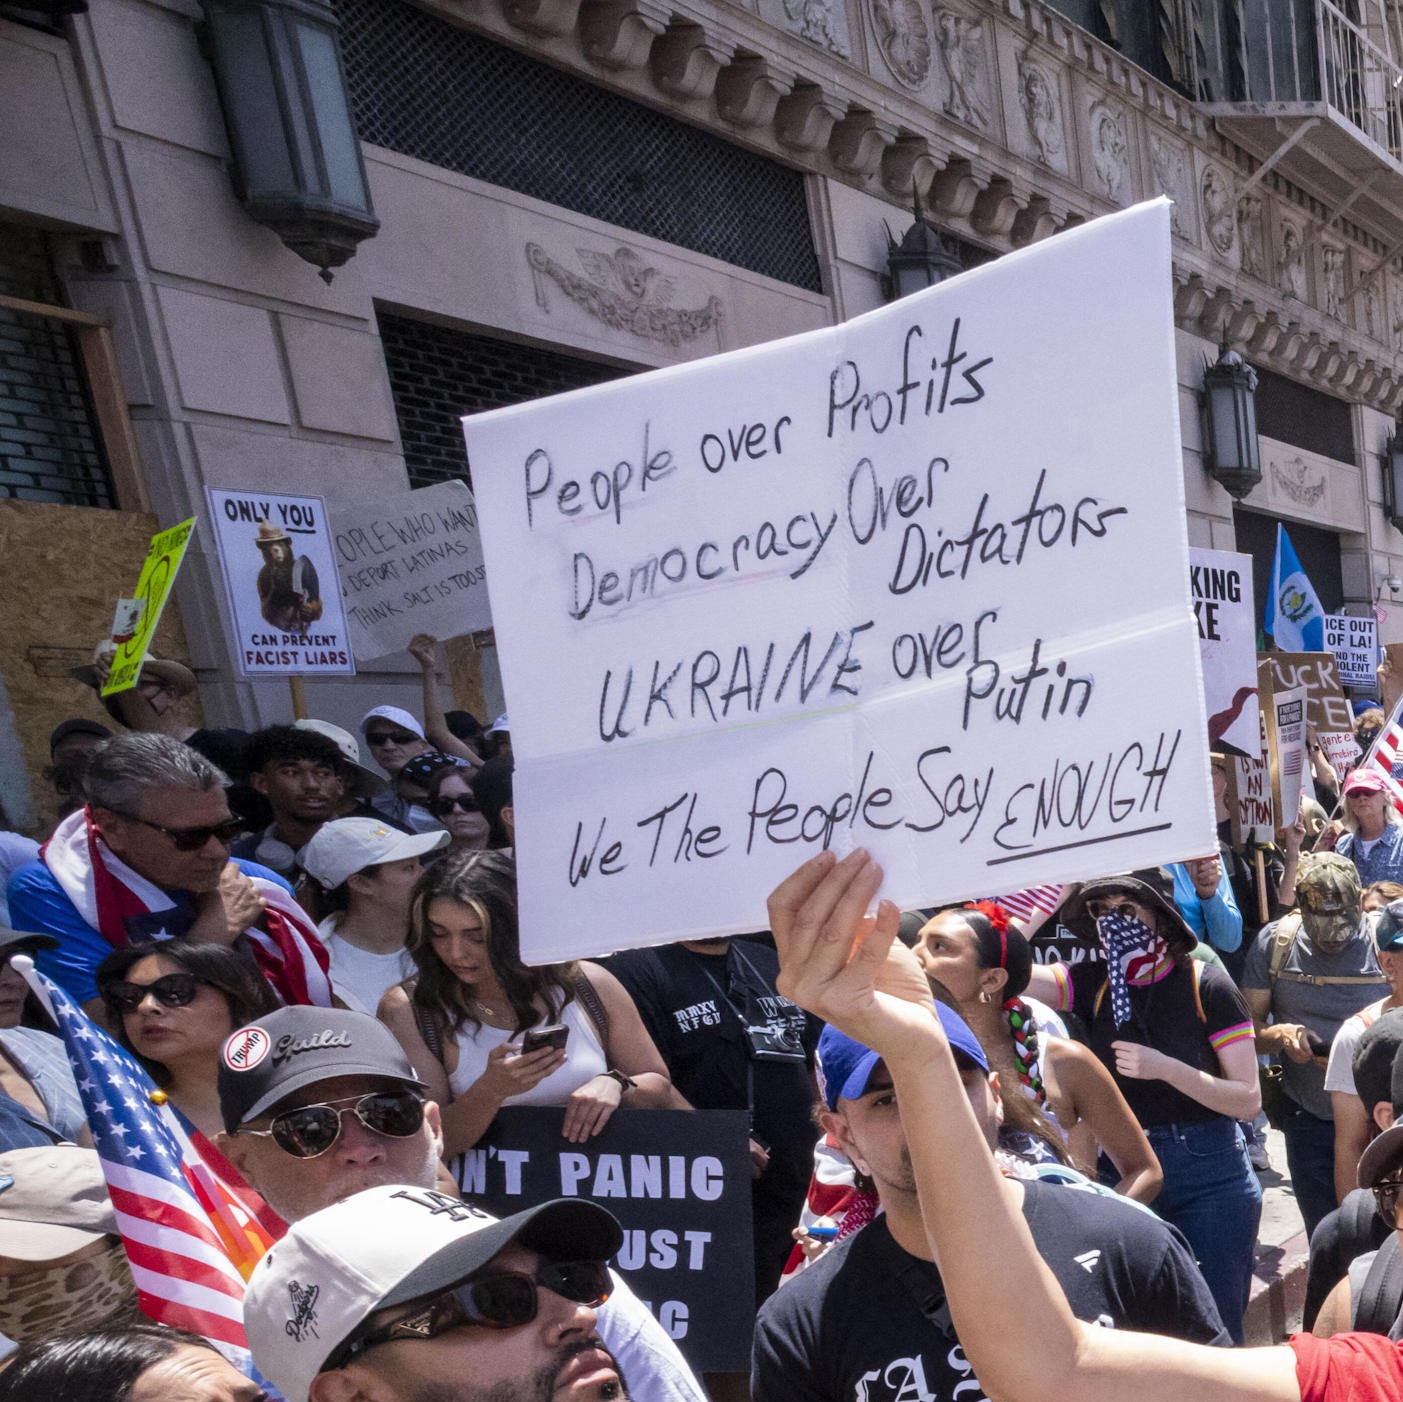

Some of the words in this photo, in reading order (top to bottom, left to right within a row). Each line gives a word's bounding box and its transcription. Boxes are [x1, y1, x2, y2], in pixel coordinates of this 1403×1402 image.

[524, 420, 676, 531] People
[700, 414, 791, 474] over
[827, 317, 994, 439] Profits
[223, 498, 271, 524] ONLY
[276, 502, 316, 528] YOU
[889, 469, 1128, 595] Dictators
[336, 520, 396, 563] OPLE
[386, 512, 437, 546] WHO
[569, 507, 838, 619] Democracy
[848, 456, 950, 546] Over
[347, 559, 401, 593] DEPORT
[401, 540, 470, 574] LATINAS
[346, 600, 405, 631] THINK
[403, 585, 433, 610] SALT
[433, 579, 452, 598] IS
[447, 570, 477, 591] TOO
[251, 633, 279, 647] CAN
[281, 633, 337, 648] PREVENT
[1325, 617, 1346, 632] ICE
[1349, 619, 1375, 634] OUT
[1326, 632, 1346, 647] OF
[1350, 634, 1373, 649] LA!
[246, 650, 299, 666] FACIST
[304, 650, 348, 666] LIARS
[599, 621, 875, 741] UKRAINE
[892, 607, 1000, 682] over
[1335, 651, 1349, 662] ND
[1350, 652, 1369, 663] THE
[1335, 660, 1371, 674] IOLENT
[962, 639, 1094, 730] Putin
[1247, 773, 1263, 797] AN
[569, 819, 625, 887] We
[637, 792, 729, 864] The
[746, 752, 901, 850] People
[904, 746, 994, 844] Say
[992, 729, 1181, 850] ENOUGH
[230, 1031, 262, 1065] TRUMP
[271, 1029, 353, 1068] Guild
[452, 1144, 530, 1196] N'T
[558, 1151, 724, 1201] PANIC
[389, 1190, 488, 1223] LA
[605, 1228, 712, 1271] UST
